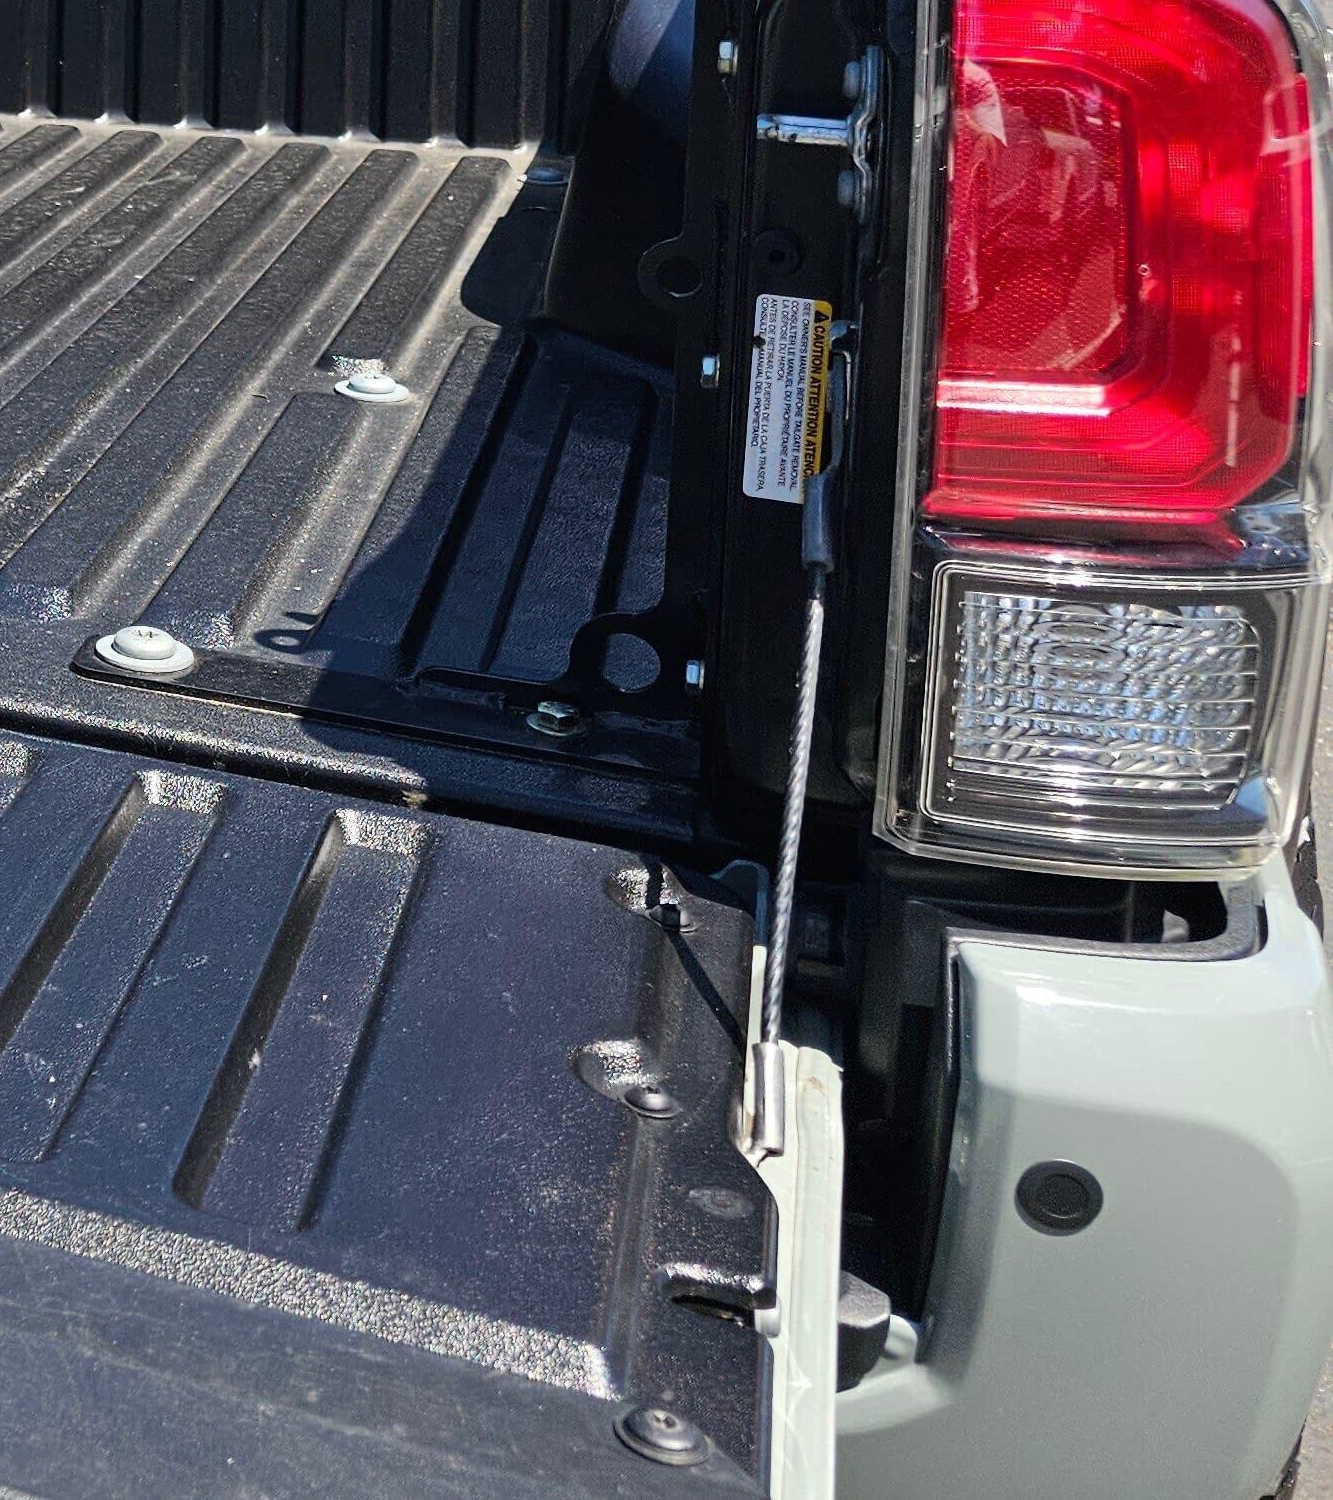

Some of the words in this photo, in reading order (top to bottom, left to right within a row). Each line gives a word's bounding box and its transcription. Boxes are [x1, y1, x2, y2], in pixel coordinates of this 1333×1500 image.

[769, 298, 777, 322] ANTES
[787, 300, 800, 345] CONSULTER
[765, 337, 774, 370] RETIRAR
[778, 343, 786, 353] DU
[810, 325, 825, 374] CAUTION
[755, 348, 764, 379] MANUAL
[784, 358, 795, 388] MANUEL
[797, 355, 807, 385] MANUAL
[754, 381, 762, 395] DEL
[762, 381, 771, 410] PUERTA
[783, 390, 791, 401] DU
[793, 387, 805, 418] BEFORE
[806, 375, 822, 437] ATTENTION
[759, 435, 767, 453] CAJA
[791, 420, 803, 452] TAILGATE
[777, 458, 787, 486] AVANTE
[803, 439, 817, 481] ATENC
